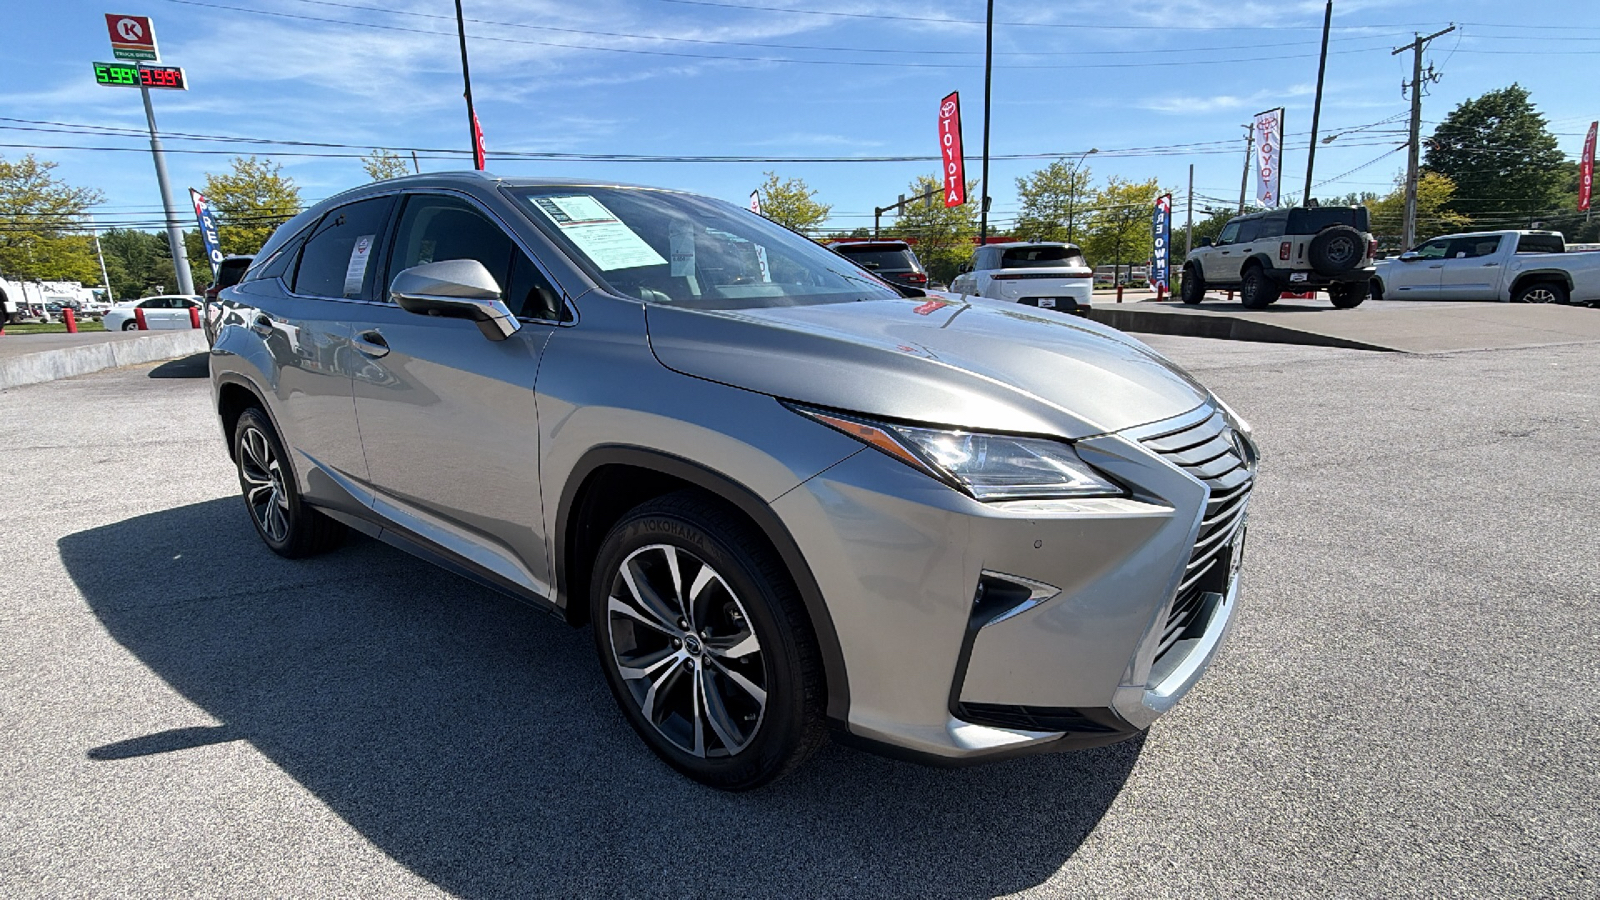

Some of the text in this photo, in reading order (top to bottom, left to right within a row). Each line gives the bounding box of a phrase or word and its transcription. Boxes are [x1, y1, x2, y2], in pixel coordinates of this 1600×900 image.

[122, 22, 142, 40] K
[943, 119, 959, 203] TOYOTA
[1261, 131, 1273, 201] TOYOTA
[643, 519, 705, 548] YOKOHAMA
